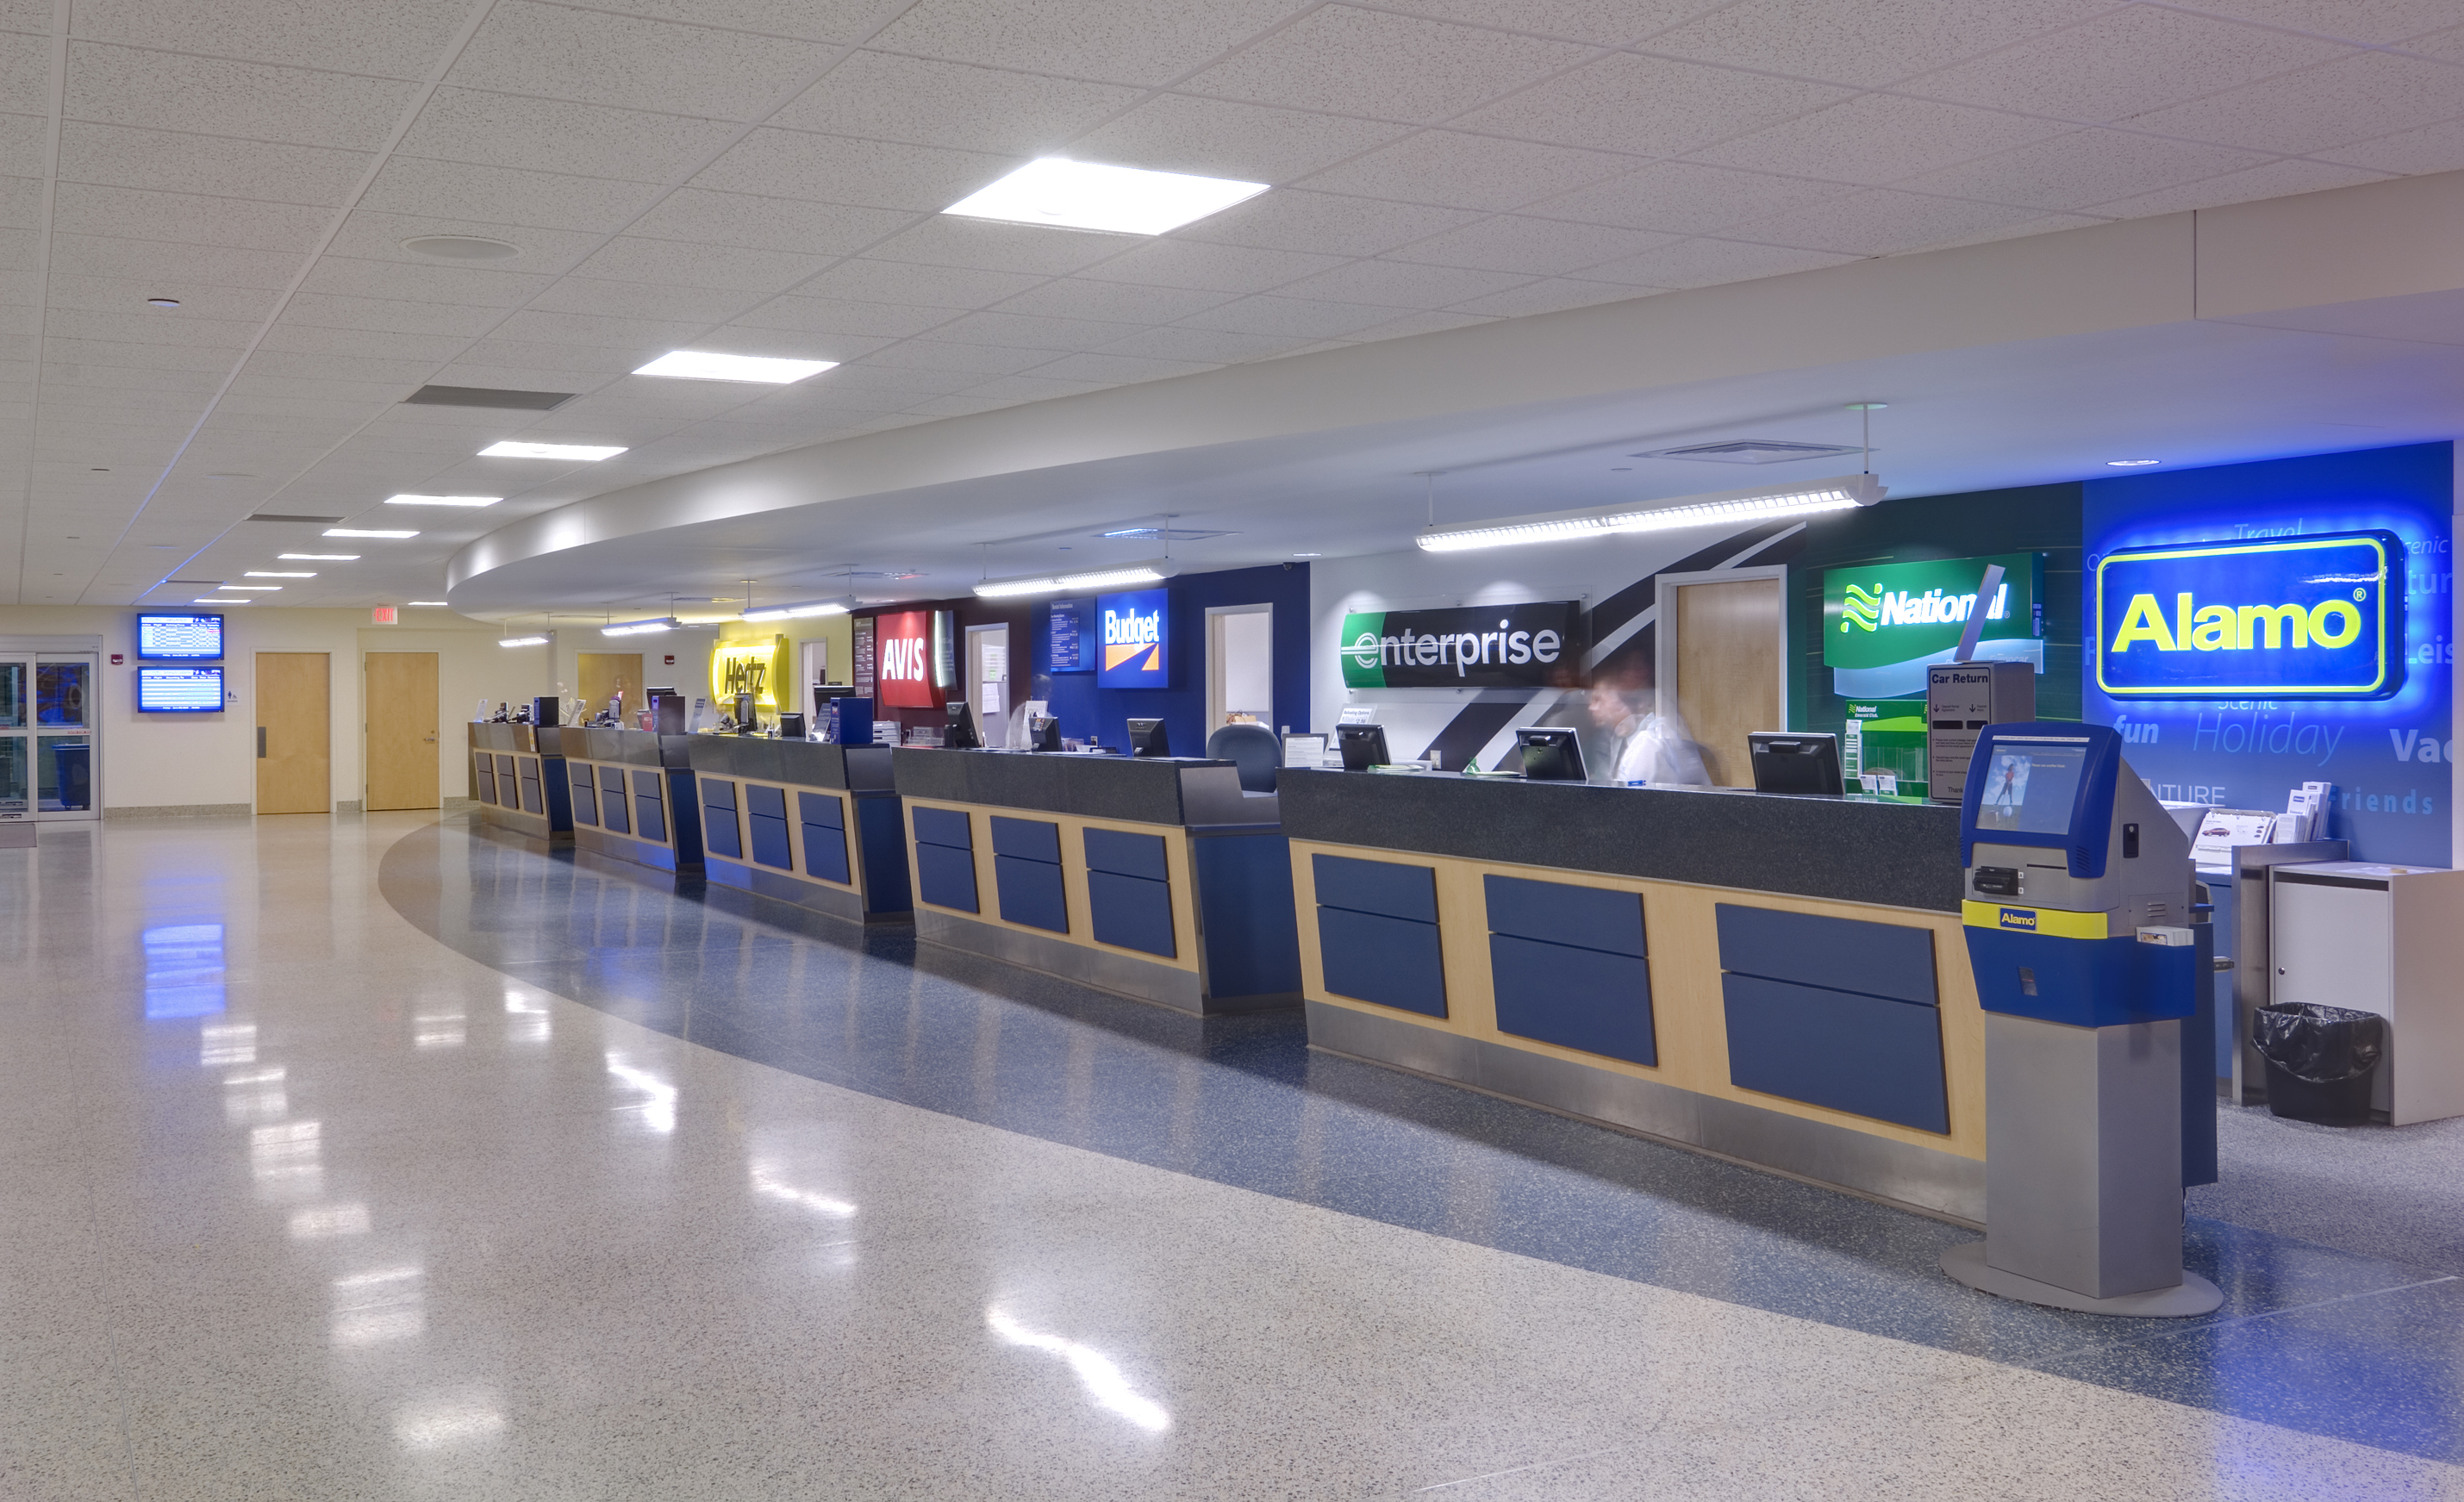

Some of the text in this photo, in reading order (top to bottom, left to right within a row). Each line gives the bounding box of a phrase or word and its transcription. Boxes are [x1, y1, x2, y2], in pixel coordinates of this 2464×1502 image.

[376, 608, 394, 621] EXIT
[1105, 608, 1159, 652] Budget
[2111, 592, 2361, 652] Alamo
[882, 638, 924, 682] AVIS
[1341, 619, 1561, 677] enterprise
[725, 657, 766, 695] Hertz
[1931, 674, 1988, 683] Car Return
[2113, 714, 2159, 744] fun
[2193, 711, 2345, 767] Holiday
[2001, 913, 2036, 926] Alamo
